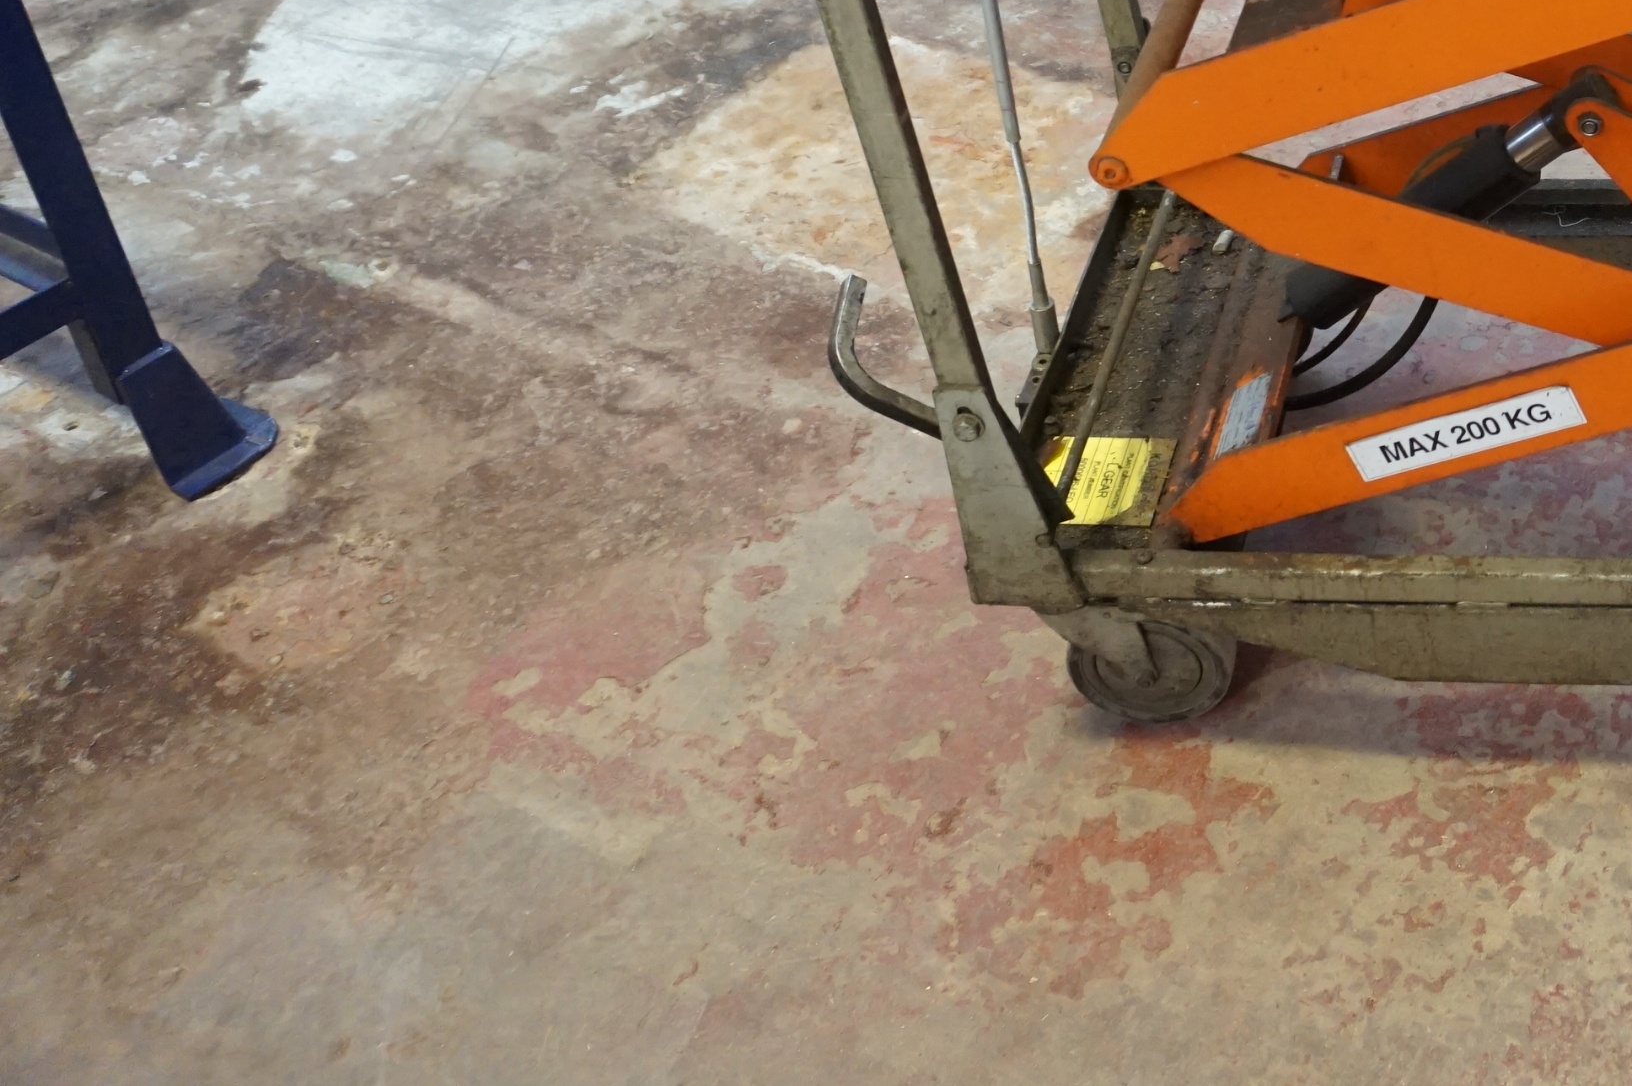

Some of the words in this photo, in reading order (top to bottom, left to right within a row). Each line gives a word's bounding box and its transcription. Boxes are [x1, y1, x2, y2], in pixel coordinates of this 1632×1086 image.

[1379, 430, 1449, 463] MAX
[1450, 416, 1501, 445] 200
[1503, 403, 1552, 429] KG
